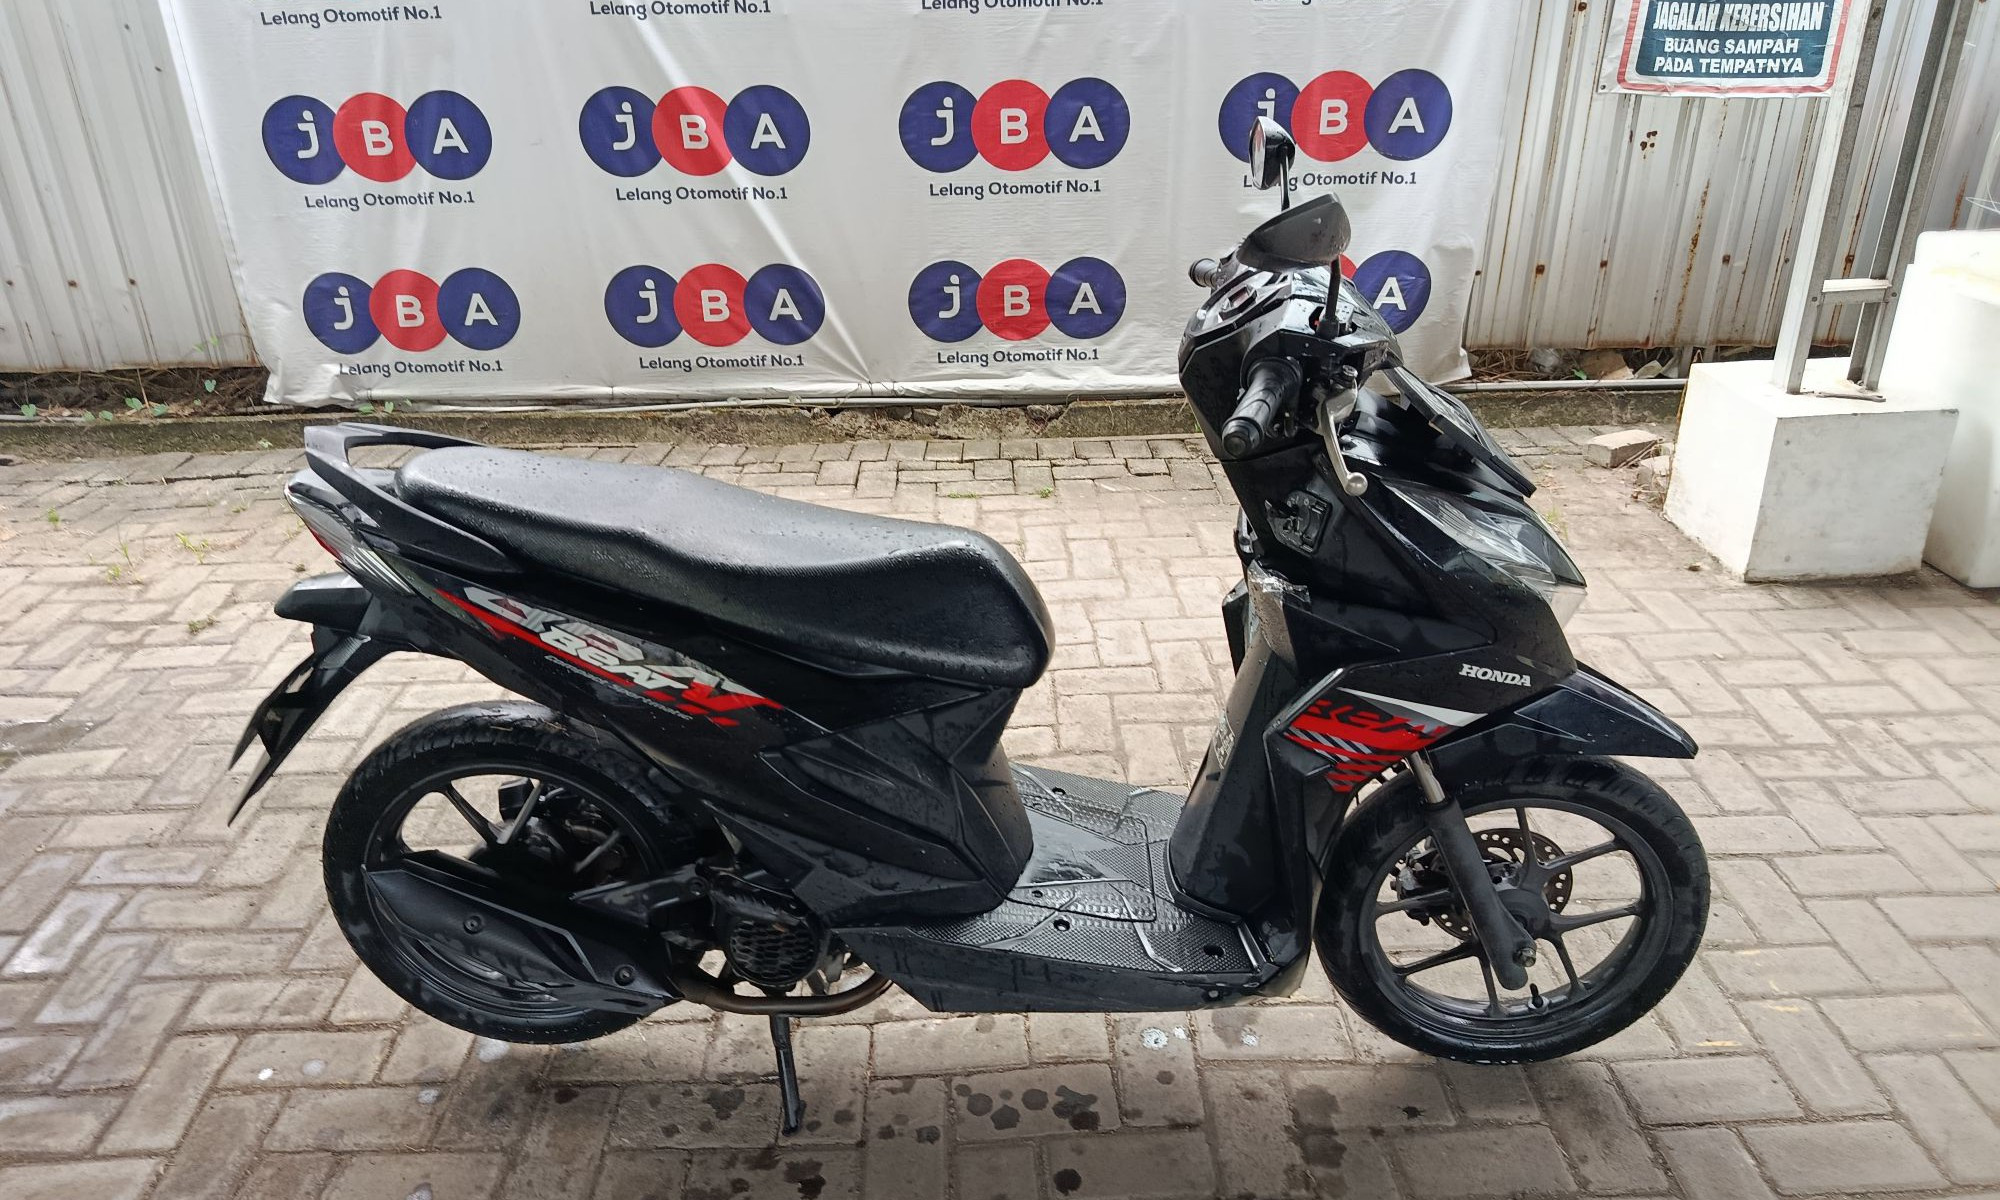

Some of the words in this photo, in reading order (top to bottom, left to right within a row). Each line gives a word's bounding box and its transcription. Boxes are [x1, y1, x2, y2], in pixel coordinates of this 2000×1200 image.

[590, 1, 648, 20] Lelang
[651, 0, 730, 15] Otomotif
[734, 0, 771, 13] No.1
[921, 0, 980, 14] Lelang
[260, 11, 321, 29] Lelang
[323, 6, 400, 23] Otomotif
[403, 5, 442, 20] No.1
[1652, 2, 1721, 31] JAGALAH
[1719, 2, 1825, 32] KEBERSIHAN
[1664, 37, 1720, 53] BUANG
[1723, 38, 1800, 54] SAMPAH
[1653, 56, 1695, 73] PADA
[1699, 57, 1804, 74] TEMPATNYA
[1302, 171, 1378, 187] Otomotif
[1381, 171, 1418, 185] No.1
[615, 187, 672, 205] Lelang
[675, 186, 749, 201] Otomotif
[752, 186, 788, 200] No.1
[929, 182, 985, 201] Lelang
[988, 179, 1064, 196] Otomotif
[1066, 179, 1102, 194] No.1
[304, 194, 360, 212] Lelang
[363, 191, 435, 207] Otomotif
[438, 190, 475, 204] No.1
[638, 356, 693, 373] Lelang
[695, 354, 768, 371] Otomotif
[770, 354, 805, 368] No.1
[937, 350, 990, 368] Lelang
[992, 347, 1064, 364] Otomotif
[1066, 348, 1100, 362] No.1
[340, 362, 392, 378] Lelang
[394, 360, 466, 374] Otomotif
[468, 360, 504, 373] No.1
[1459, 663, 1532, 687] HONDA
